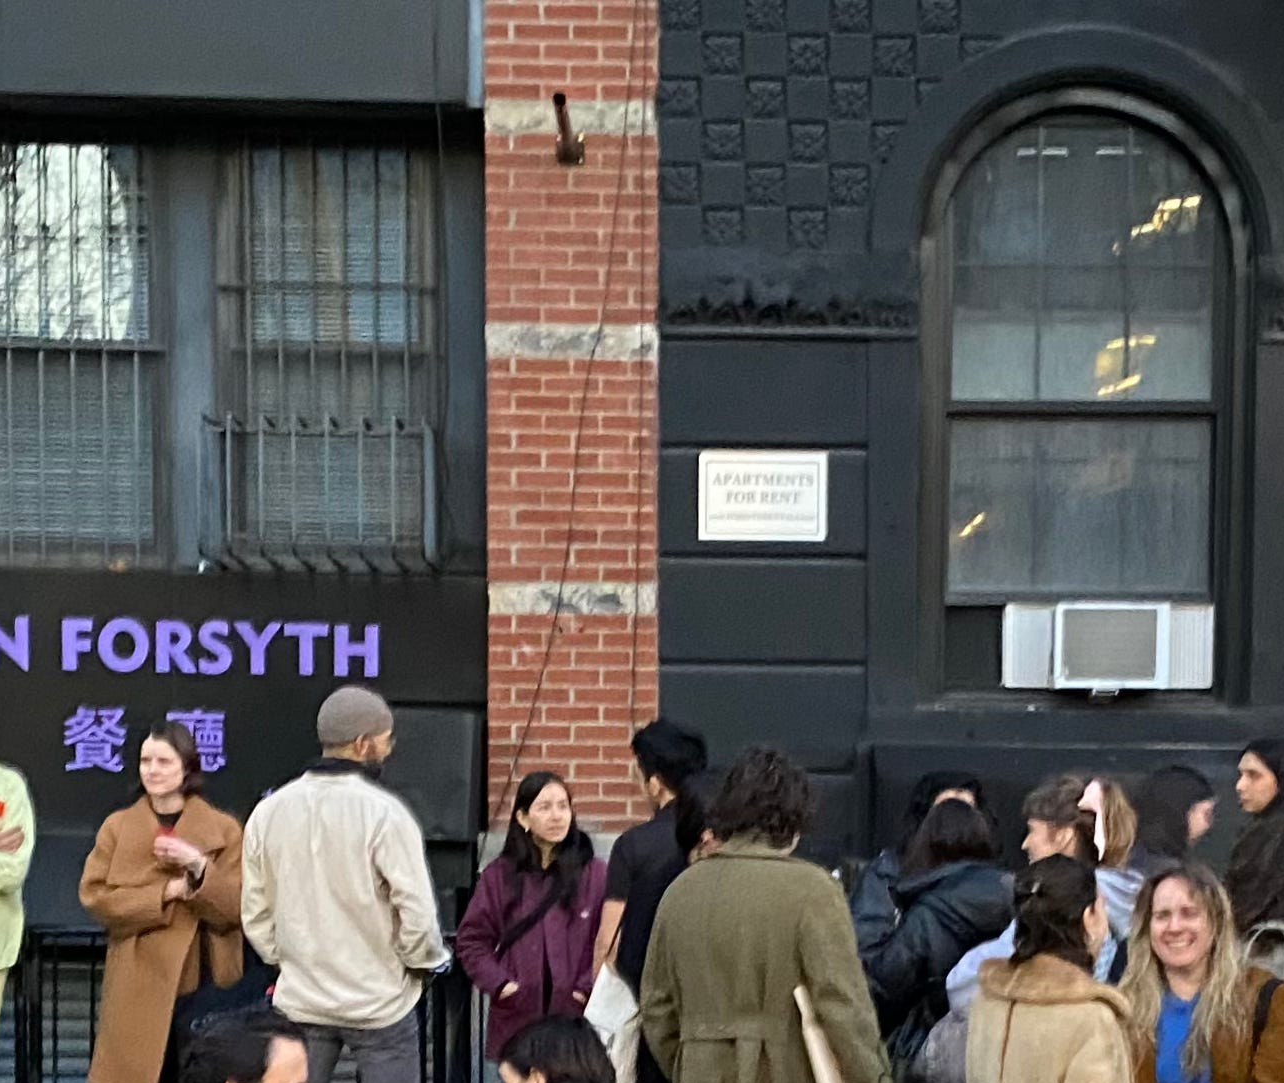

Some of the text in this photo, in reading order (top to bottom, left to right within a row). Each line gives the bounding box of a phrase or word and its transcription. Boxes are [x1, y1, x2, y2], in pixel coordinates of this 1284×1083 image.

[712, 471, 814, 487] APARTMENTS
[726, 490, 801, 504] FOR RENT
[60, 617, 381, 679] FORSYTH
